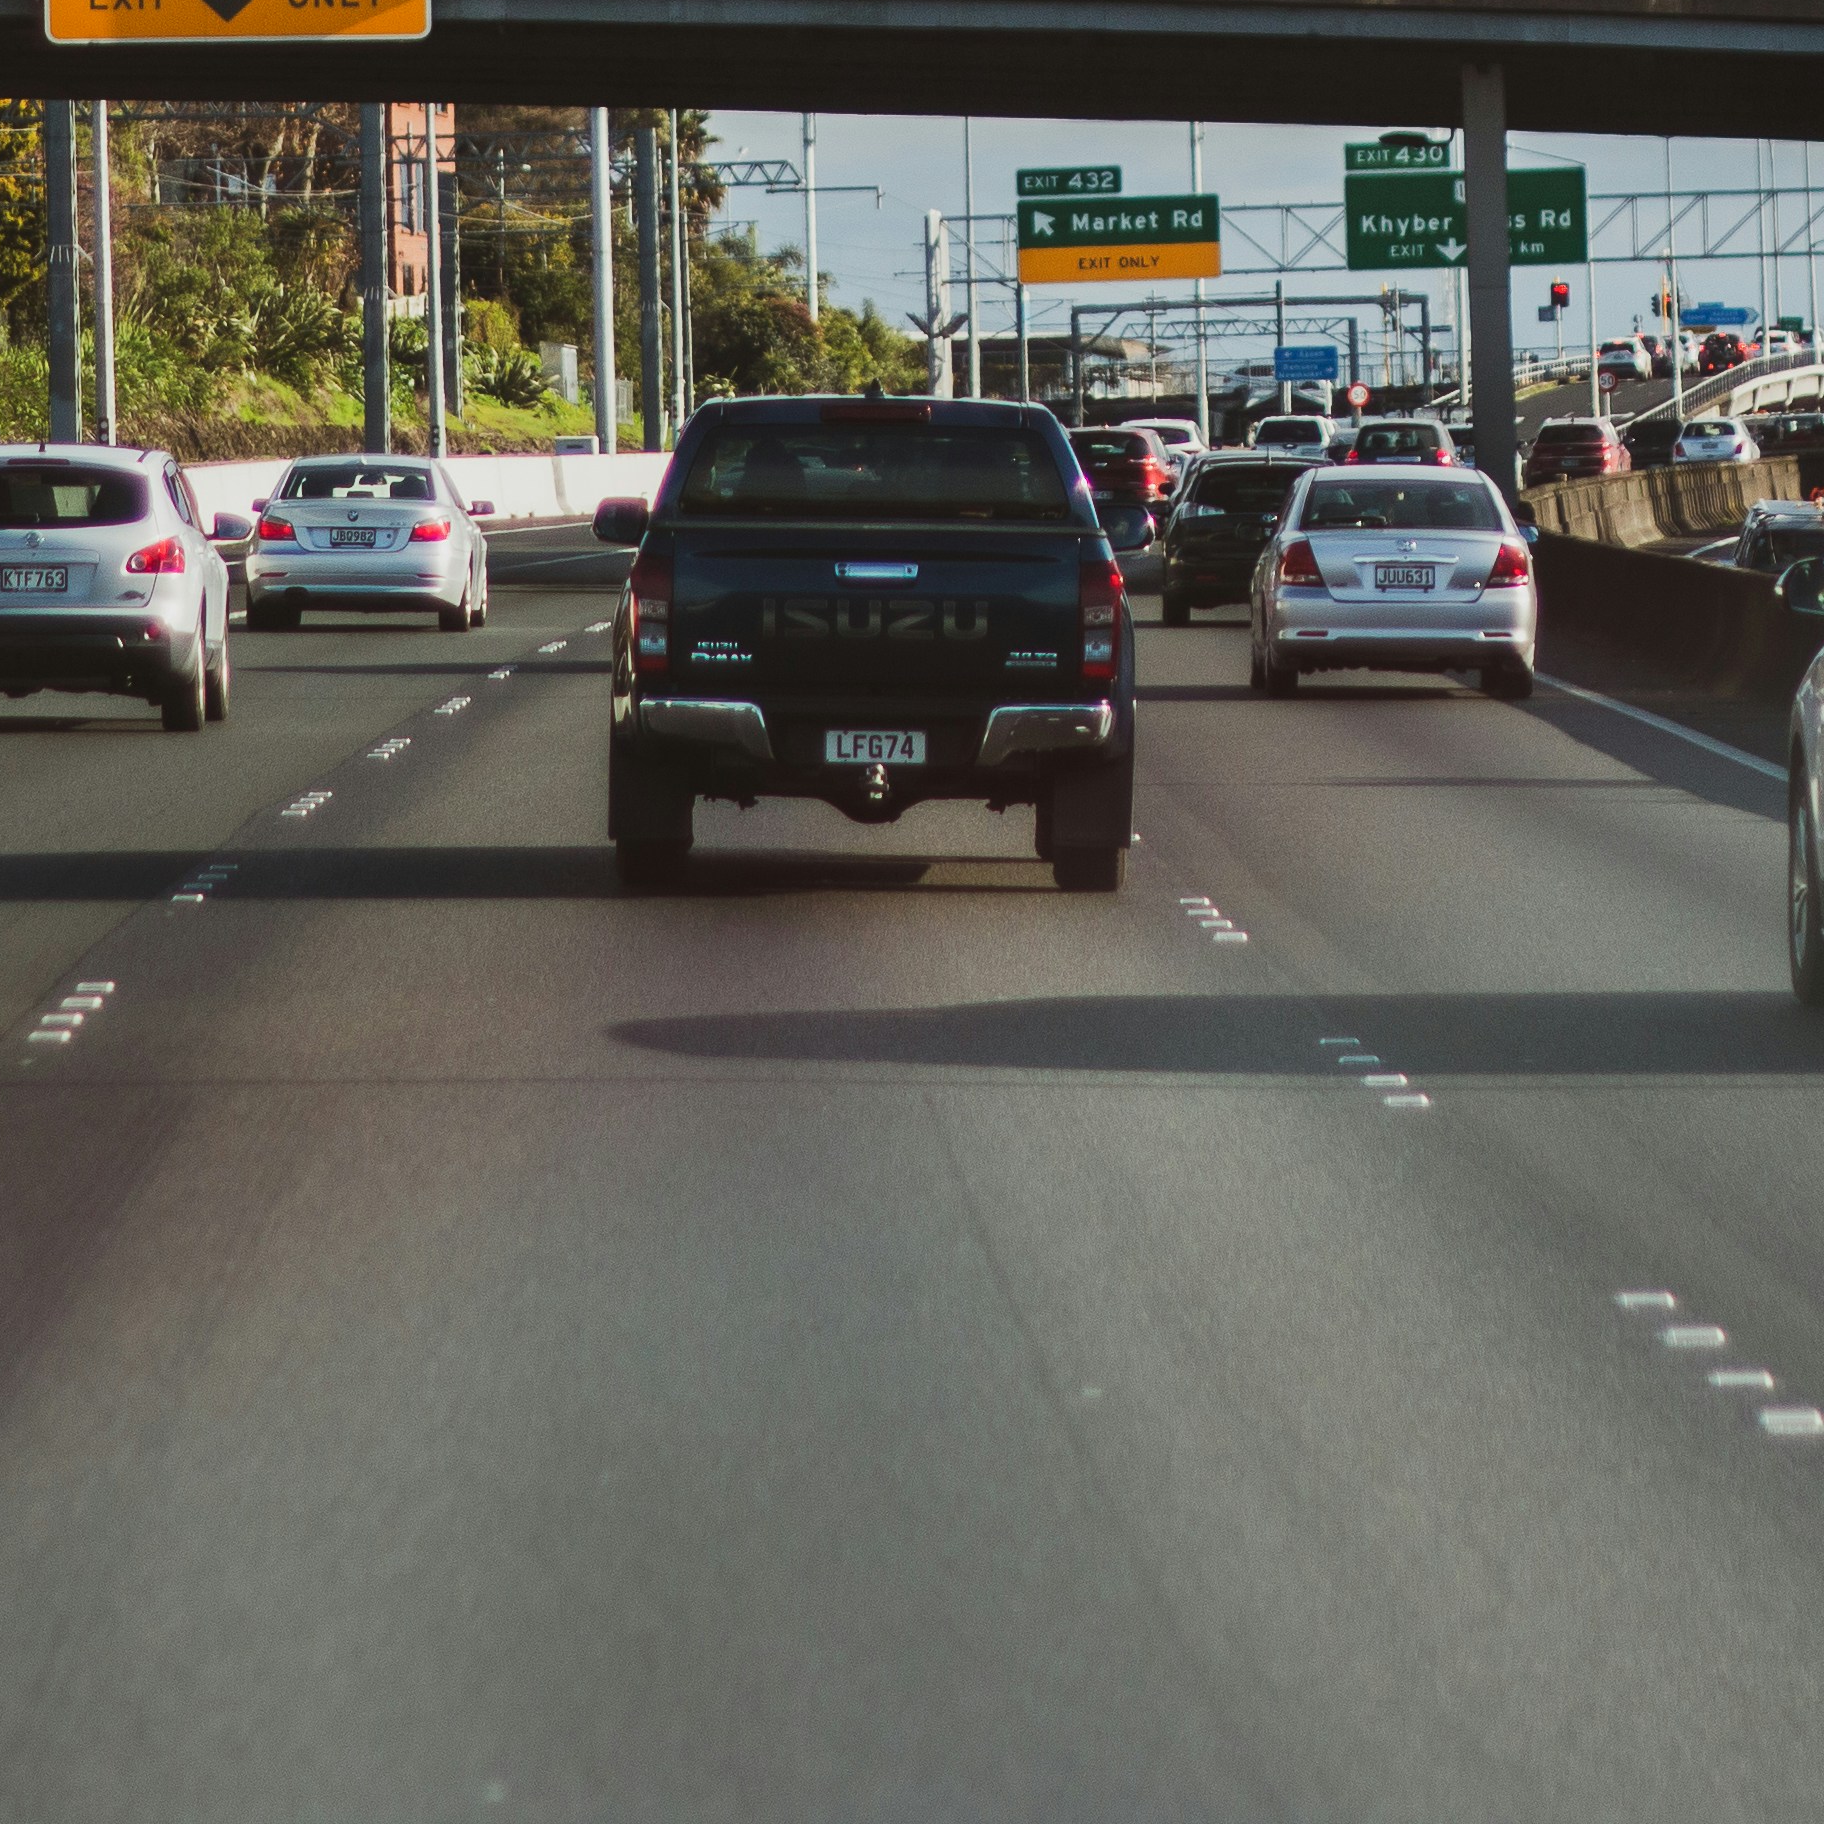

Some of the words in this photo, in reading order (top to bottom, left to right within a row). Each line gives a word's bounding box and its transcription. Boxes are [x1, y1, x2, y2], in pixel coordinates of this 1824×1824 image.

[1356, 149, 1391, 163] EXIT
[1395, 144, 1443, 162] 430
[1024, 175, 1059, 189] EXIT
[1068, 171, 1115, 189] 432
[1071, 210, 1160, 231] Market
[1173, 209, 1204, 228] Rd
[1361, 212, 1453, 237] Khyber
[1540, 208, 1572, 228] Rd
[1390, 243, 1426, 257] EXIT
[1520, 241, 1545, 254] km
[1078, 256, 1112, 270] EXIT
[1119, 255, 1160, 269] ONLY
[1601, 377, 1614, 386] 50
[1354, 390, 1366, 399] 50
[3, 570, 66, 588] KTF763
[1378, 569, 1430, 584] JUU631
[763, 599, 989, 640] ISUZU
[835, 733, 916, 761] LFG74
